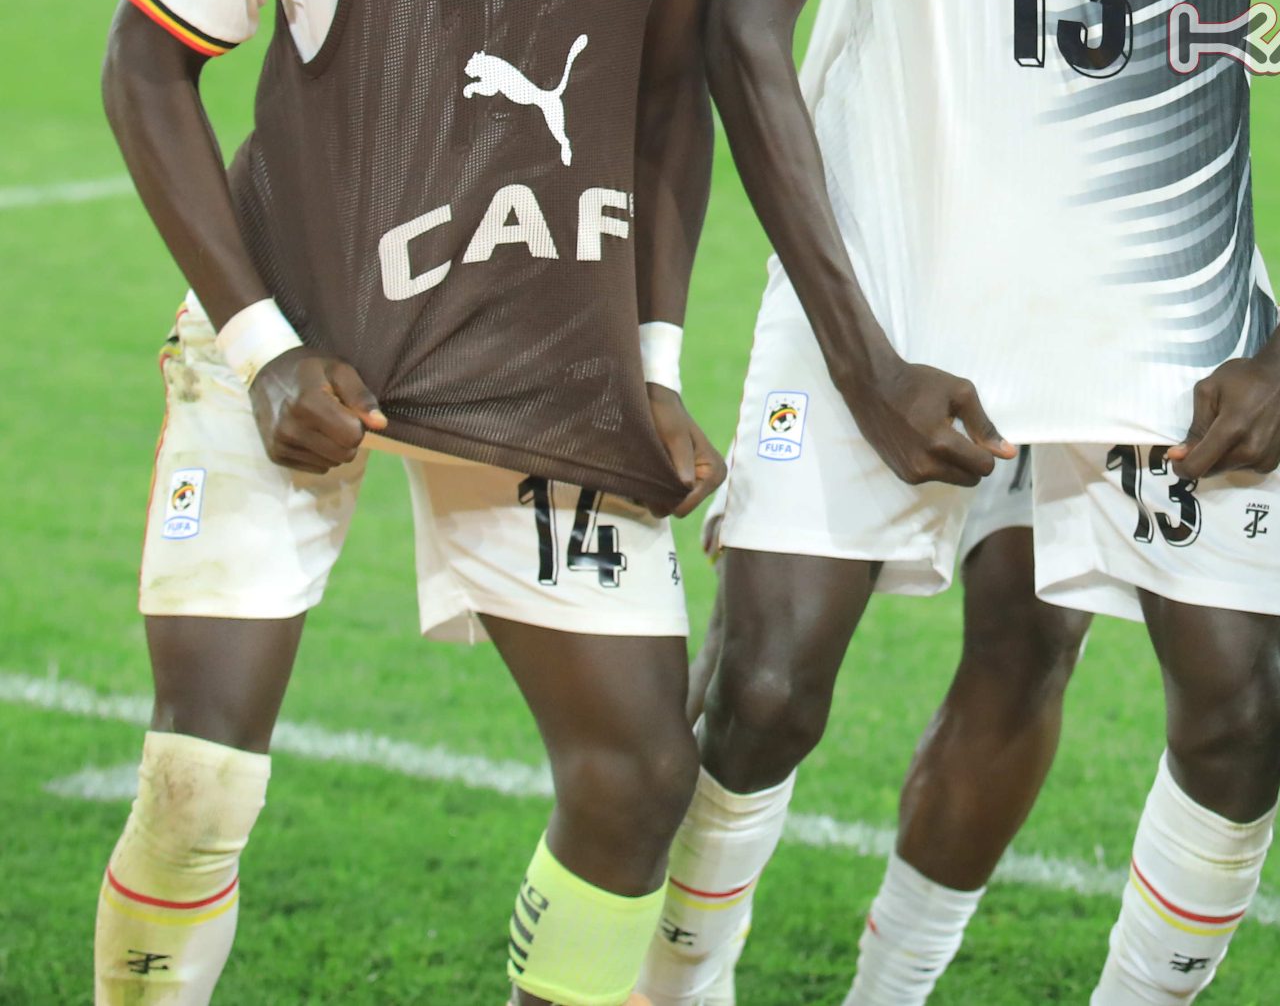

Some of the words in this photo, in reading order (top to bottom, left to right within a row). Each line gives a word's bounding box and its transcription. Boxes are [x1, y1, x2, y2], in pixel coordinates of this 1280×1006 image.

[378, 184, 630, 301] CAF
[765, 442, 793, 453] FUFA
[1106, 444, 1202, 548] 13
[518, 475, 628, 588] 14
